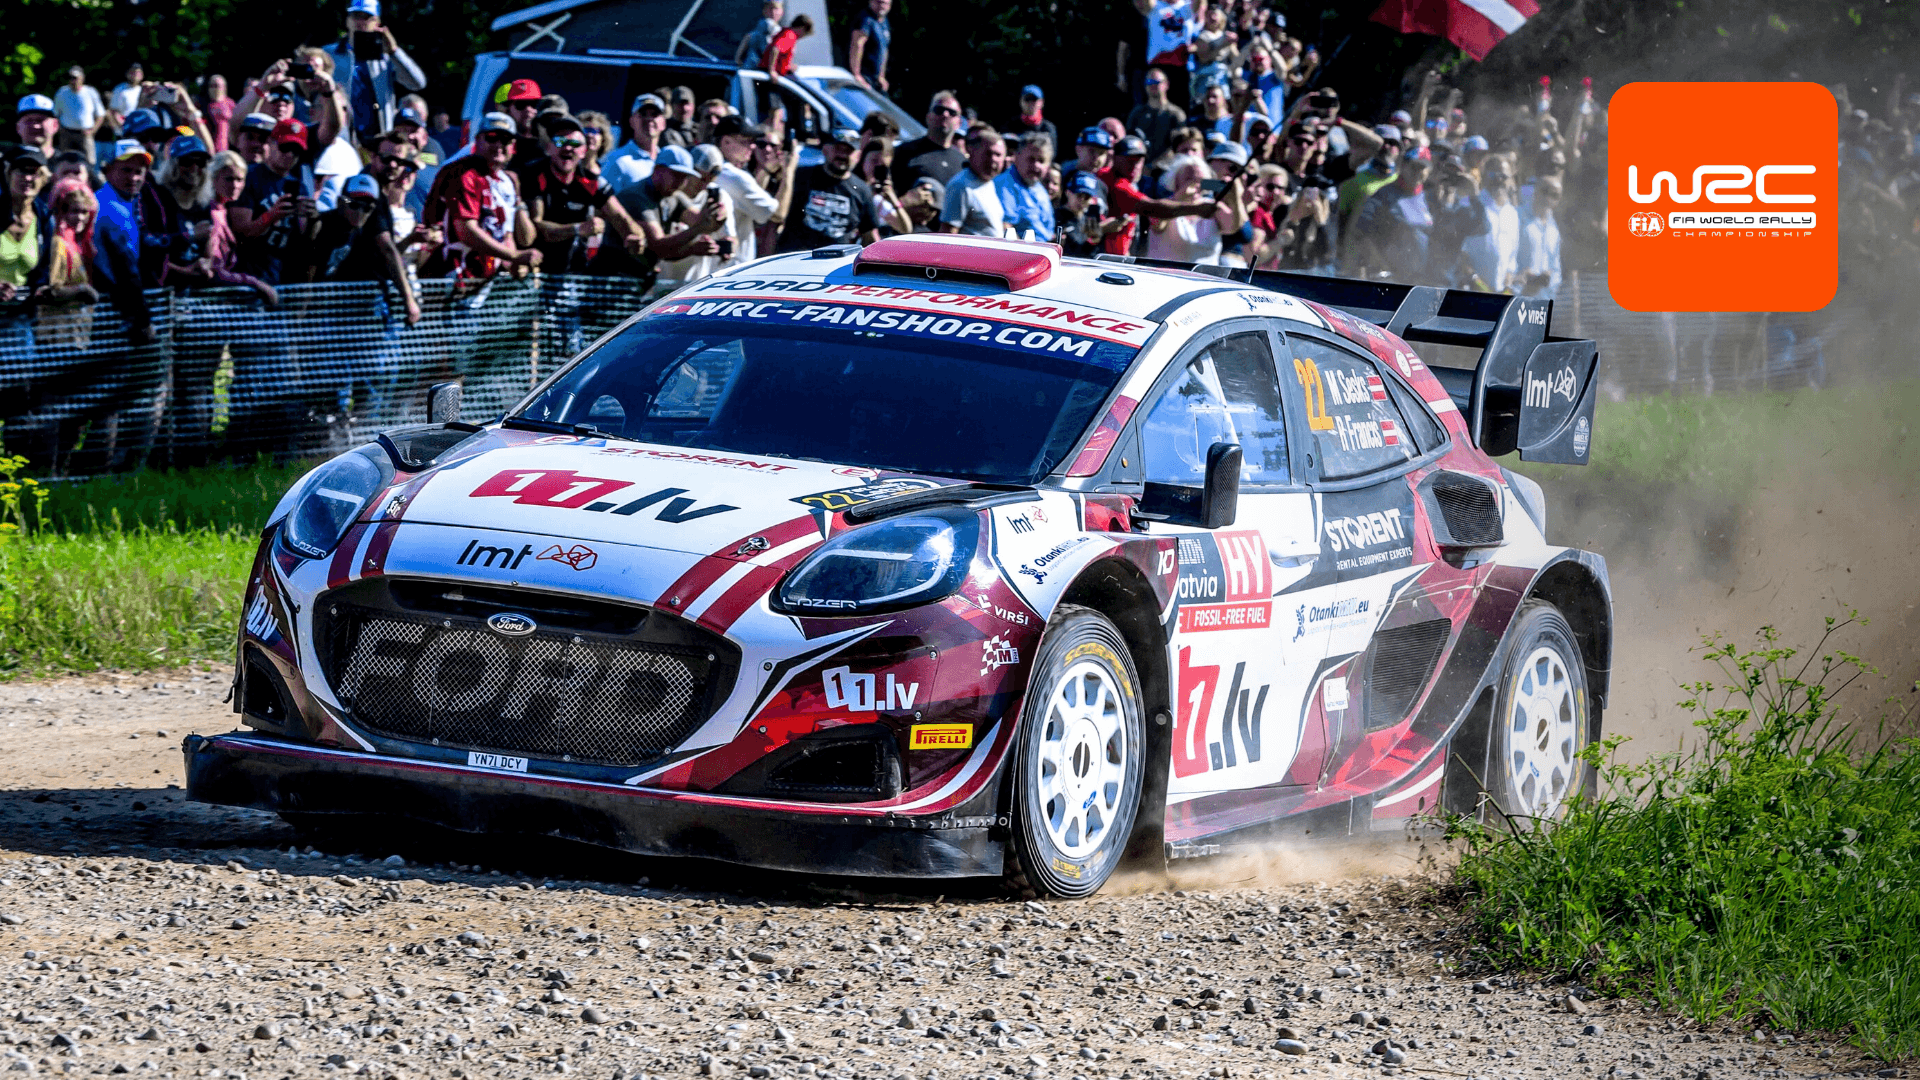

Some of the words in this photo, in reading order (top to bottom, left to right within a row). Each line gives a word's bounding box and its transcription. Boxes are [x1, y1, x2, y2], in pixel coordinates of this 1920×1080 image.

[685, 301, 1095, 357] WRC-FANSHOP.COM
[1293, 358, 1334, 431] 22
[1336, 368, 1370, 404] Sesks
[1525, 370, 1553, 409] lmt
[1344, 412, 1383, 450] Francis
[600, 448, 799, 472] STORENT
[500, 471, 742, 523] 11.lv
[801, 492, 870, 510] 22
[1006, 512, 1035, 534] lmt
[1324, 507, 1405, 553] STORENT
[293, 539, 327, 559] LAZER
[456, 539, 534, 570] lmt
[1336, 557, 1359, 571] RENTAL
[1358, 551, 1389, 567] EQUIPMENT
[1389, 545, 1413, 561] EXPERTS
[1220, 535, 1264, 595] HY
[1178, 568, 1218, 598] atvia
[782, 597, 857, 609] LAZER
[994, 604, 1029, 626] VIRŠI
[1194, 607, 1246, 627] FOSSIL-FREE
[1247, 606, 1266, 624] FUEL
[496, 616, 525, 631] Ford
[337, 619, 694, 734] FORD
[826, 667, 919, 711] 11.lv
[1183, 661, 1271, 772] 1.lv
[915, 728, 968, 745] PIRELLI
[474, 754, 499, 768] YN71
[500, 757, 522, 770] DCY
